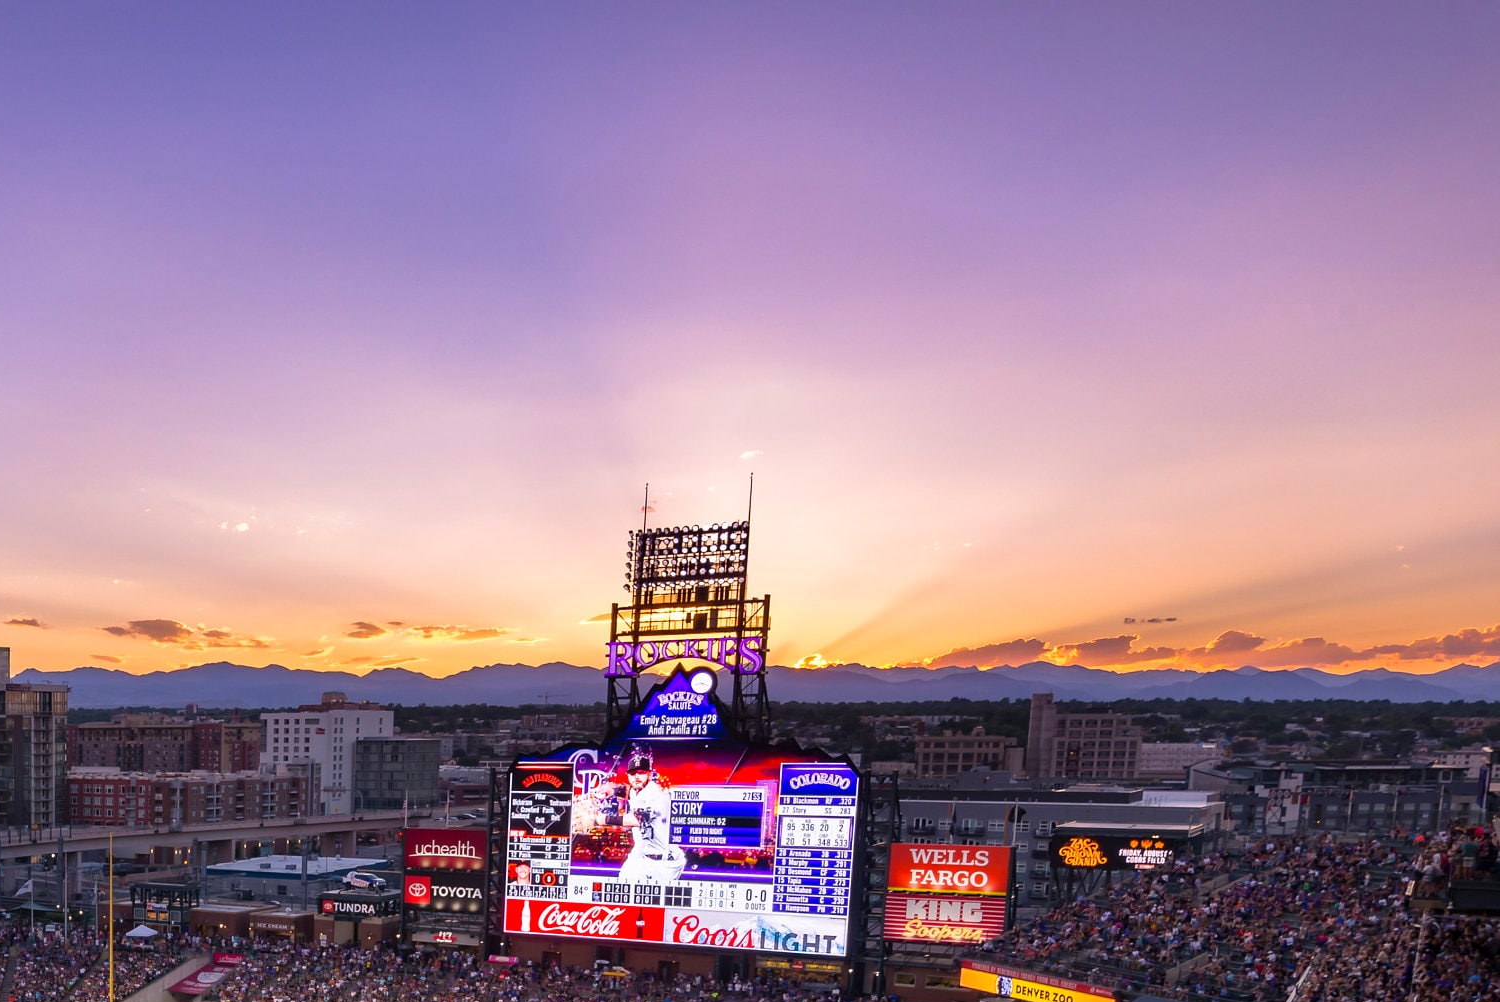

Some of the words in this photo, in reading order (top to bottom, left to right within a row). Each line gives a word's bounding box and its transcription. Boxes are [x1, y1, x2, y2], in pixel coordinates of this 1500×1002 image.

[605, 637, 763, 676] ROCKIES
[657, 691, 704, 706] ROCKIES
[668, 702, 692, 710] SALUTE
[640, 715, 660, 727] Emily
[661, 714, 700, 727] Sauvageau
[701, 714, 717, 724] #28
[648, 725, 665, 736] Andi
[666, 725, 690, 736] Padilla
[692, 725, 707, 735] #13
[789, 772, 851, 790] COLORADO
[673, 791, 700, 800] TREVOR
[742, 792, 751, 800] 27
[672, 802, 704, 815] STORY
[670, 816, 687, 825] GAME
[820, 824, 829, 832] 20
[415, 840, 476, 857] uchealth
[802, 838, 810, 846] 51
[910, 848, 989, 866] WELLS
[1118, 848, 1142, 857] FRIDAY,
[909, 869, 988, 888] FARGO
[431, 886, 483, 899] TOYOTA
[334, 902, 376, 914] TUNDRA
[905, 899, 983, 923] KING
[538, 902, 626, 937] Coca-Cola
[672, 914, 755, 948] Coors
[760, 930, 837, 954] LIGHT
[902, 918, 984, 943] Soopers
[1016, 984, 1050, 1001] DENVER
